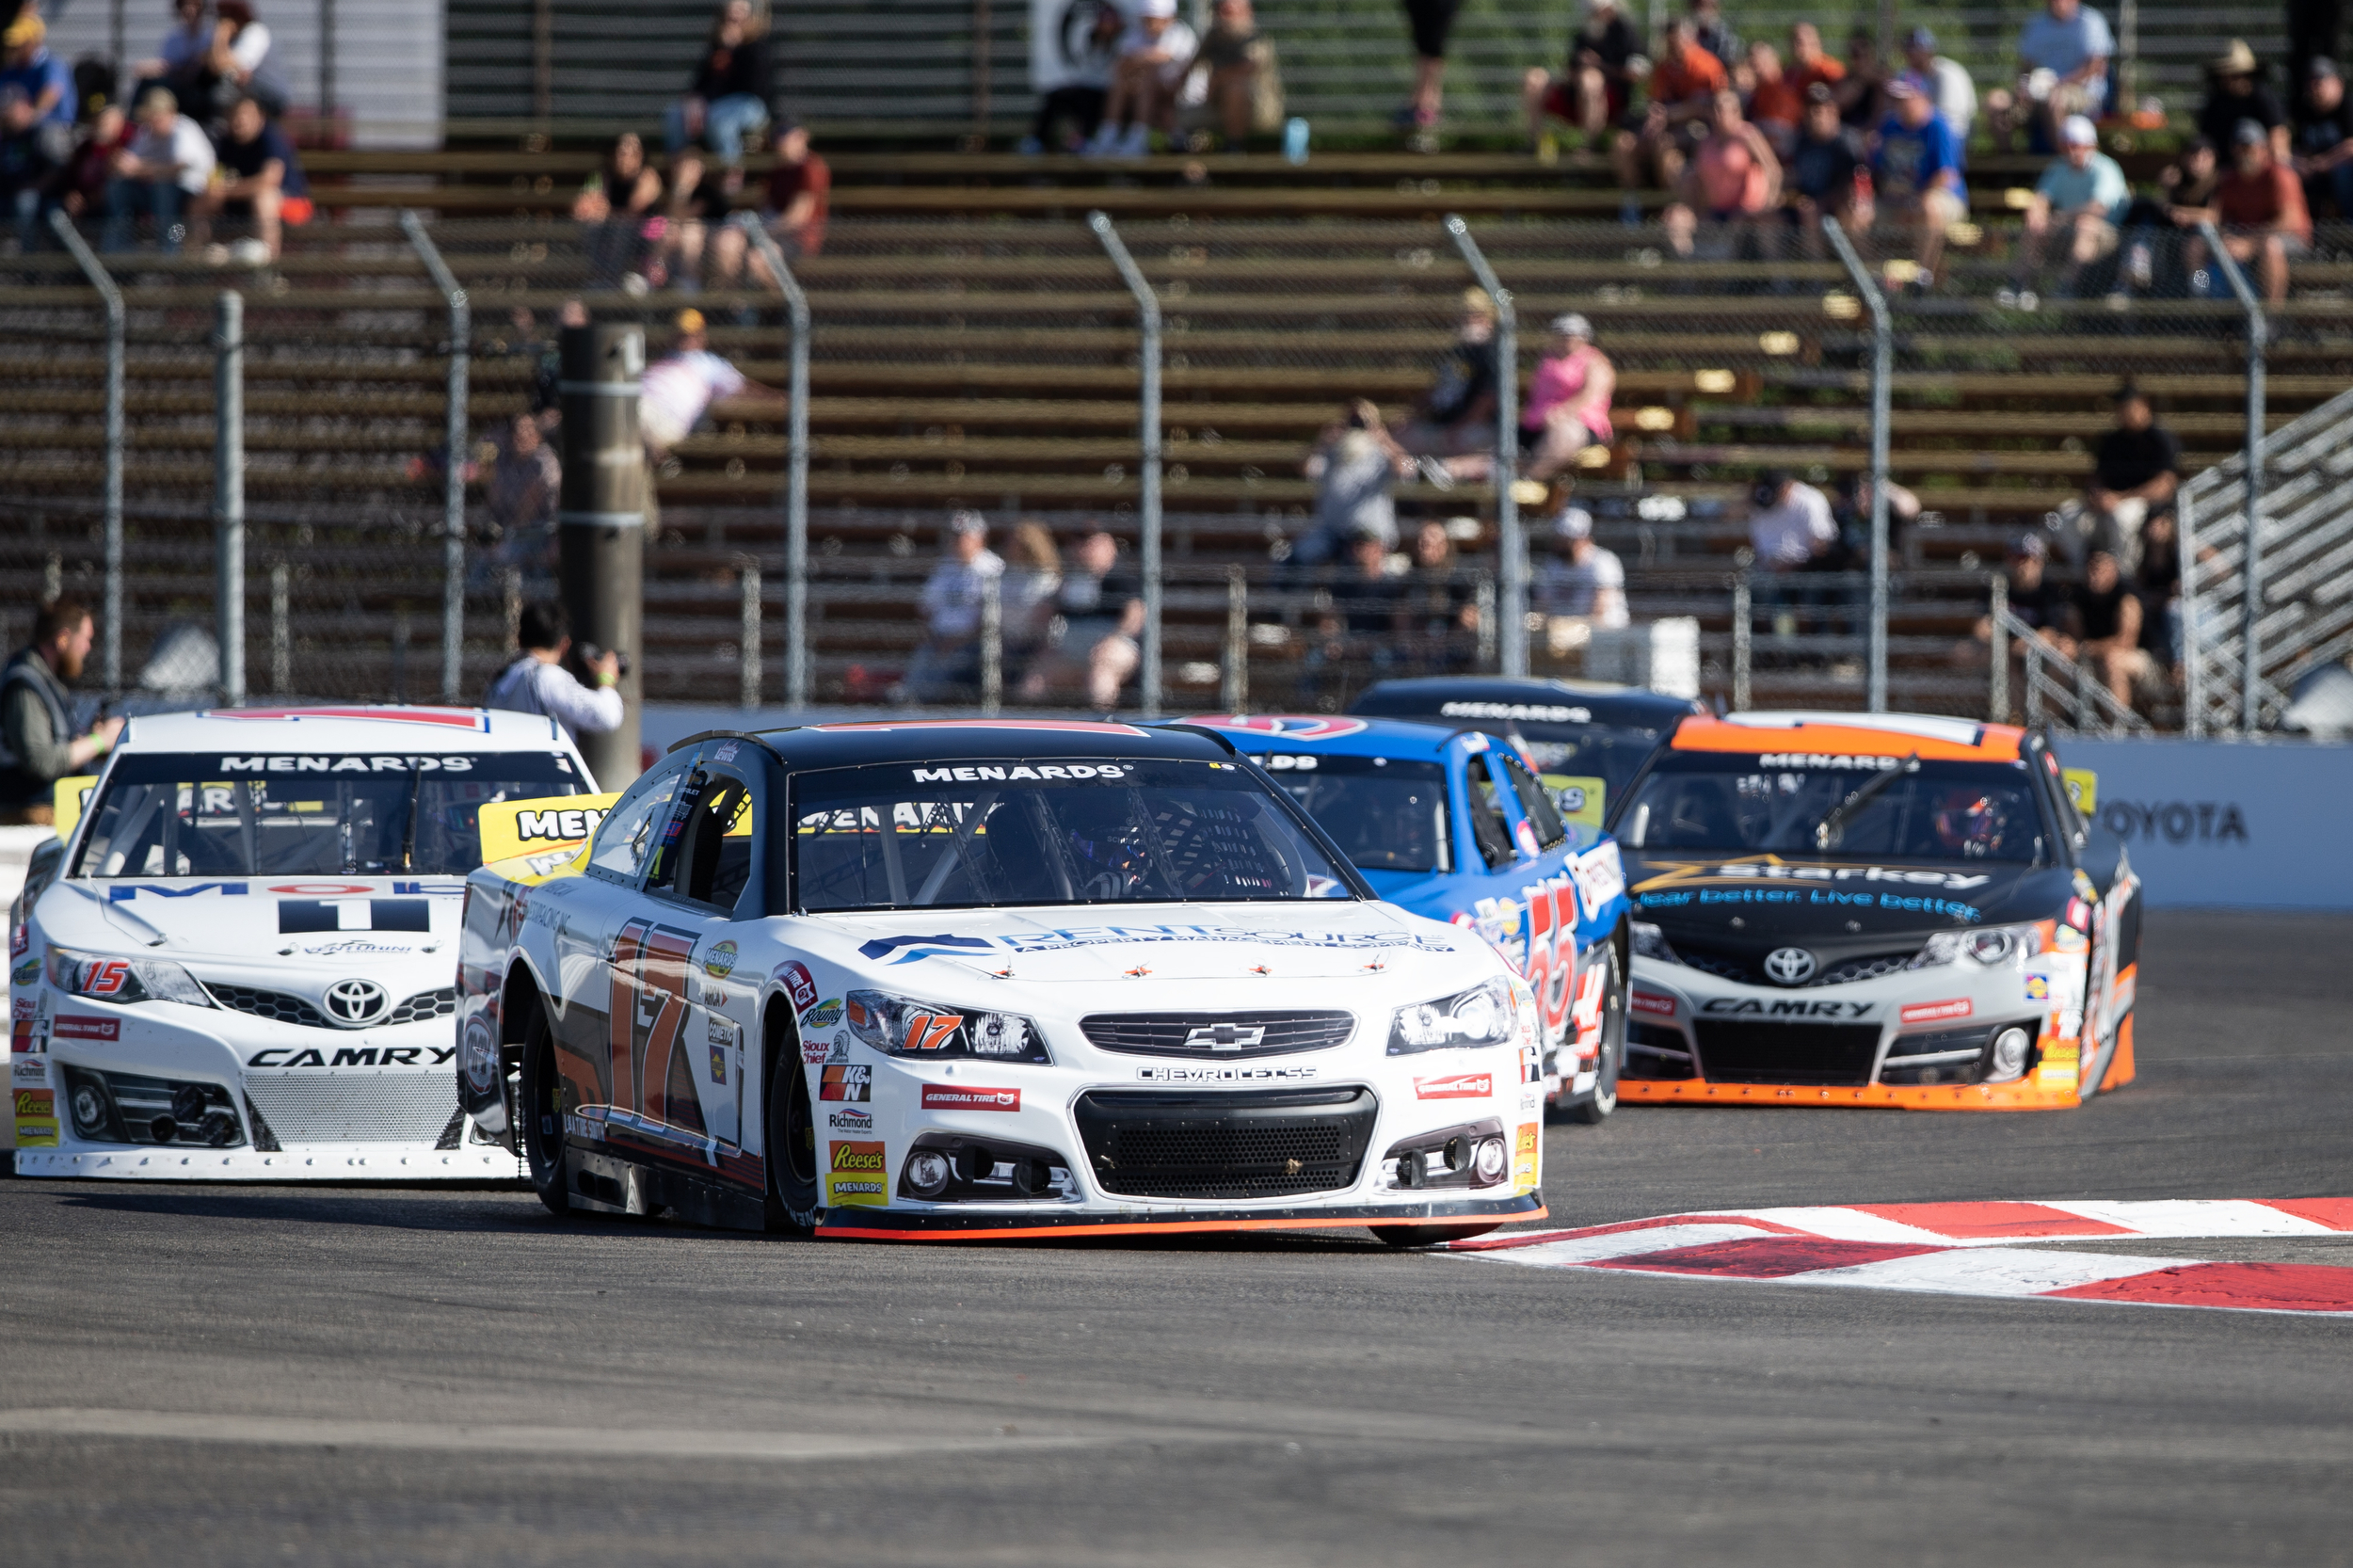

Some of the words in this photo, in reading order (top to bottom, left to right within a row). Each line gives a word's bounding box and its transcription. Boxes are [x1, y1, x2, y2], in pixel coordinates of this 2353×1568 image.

[219, 756, 474, 773] MENARDS
[912, 764, 1126, 783] MENARDS
[2098, 799, 2249, 846] OYOTA
[1718, 864, 1992, 890] Starkey
[1809, 888, 1875, 907] Live
[318, 899, 373, 931] 1
[703, 947, 738, 970] MENARDS
[80, 960, 132, 994] 15
[704, 984, 721, 1007] ARCA
[1702, 998, 1877, 1018] CAMRY
[607, 916, 703, 1133] 17
[800, 1007, 844, 1031] Bounty
[901, 1015, 965, 1050] 17
[802, 1040, 830, 1052] Sioux
[247, 1046, 456, 1067] CAMRY
[802, 1053, 826, 1064] Chief
[840, 1065, 871, 1084] K&
[1417, 1082, 1459, 1094] GENERAL
[1458, 1080, 1478, 1091] TIRE
[925, 1093, 971, 1102] GENERAL
[972, 1094, 997, 1103] TIRE
[829, 1112, 872, 1128] Richmond
[833, 1144, 884, 1169] Reese's
[833, 1181, 883, 1193] MENARDS
